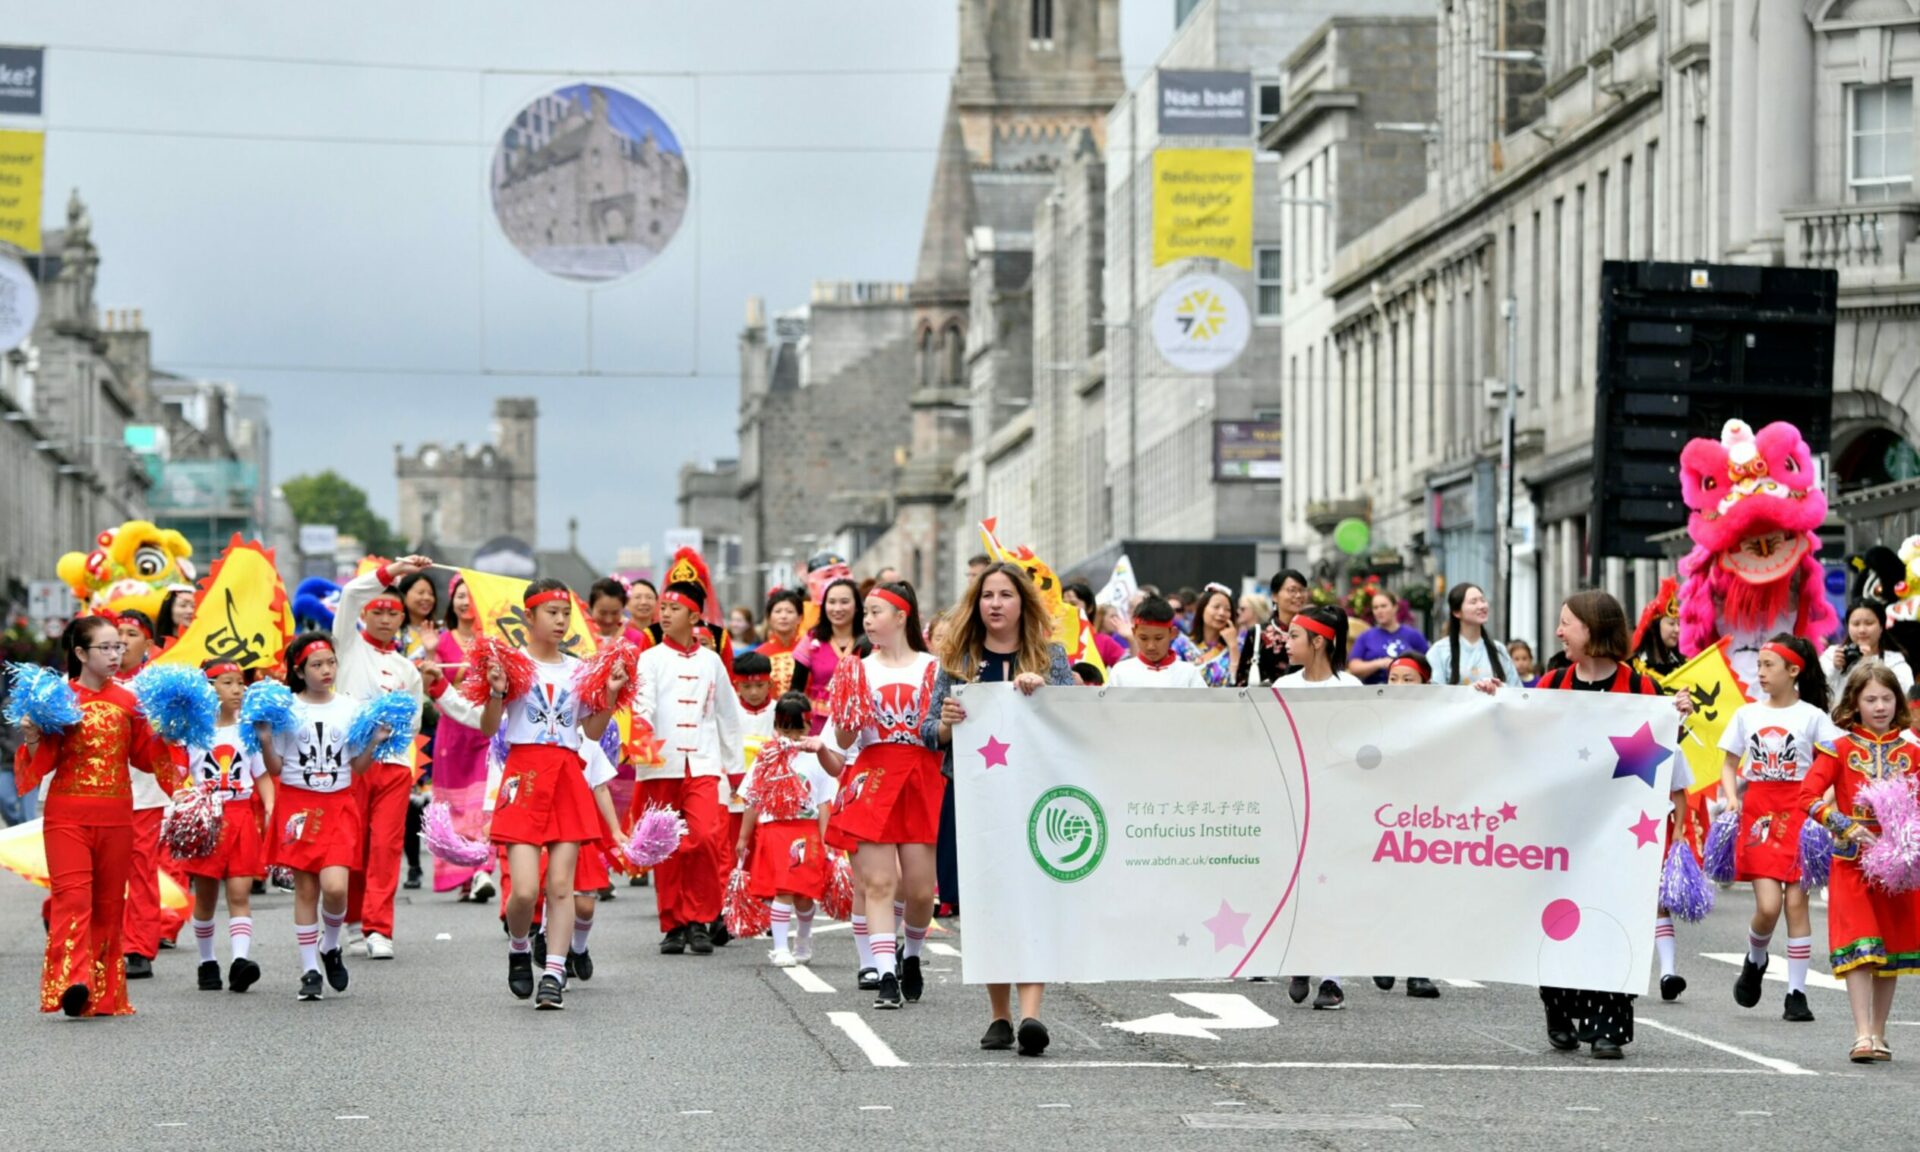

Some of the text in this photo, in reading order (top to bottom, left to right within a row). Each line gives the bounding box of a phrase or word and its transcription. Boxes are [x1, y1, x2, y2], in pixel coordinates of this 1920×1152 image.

[1164, 87, 1244, 106] Nae bad!
[1127, 800, 1261, 815] 阿伯丁大学孔子学院
[1374, 803, 1500, 832] Celebrate
[1125, 823, 1262, 838] Confucius Institute
[1372, 830, 1569, 871] Aberdeen
[1125, 854, 1260, 866] www.abdn.ac.uk/confucius
